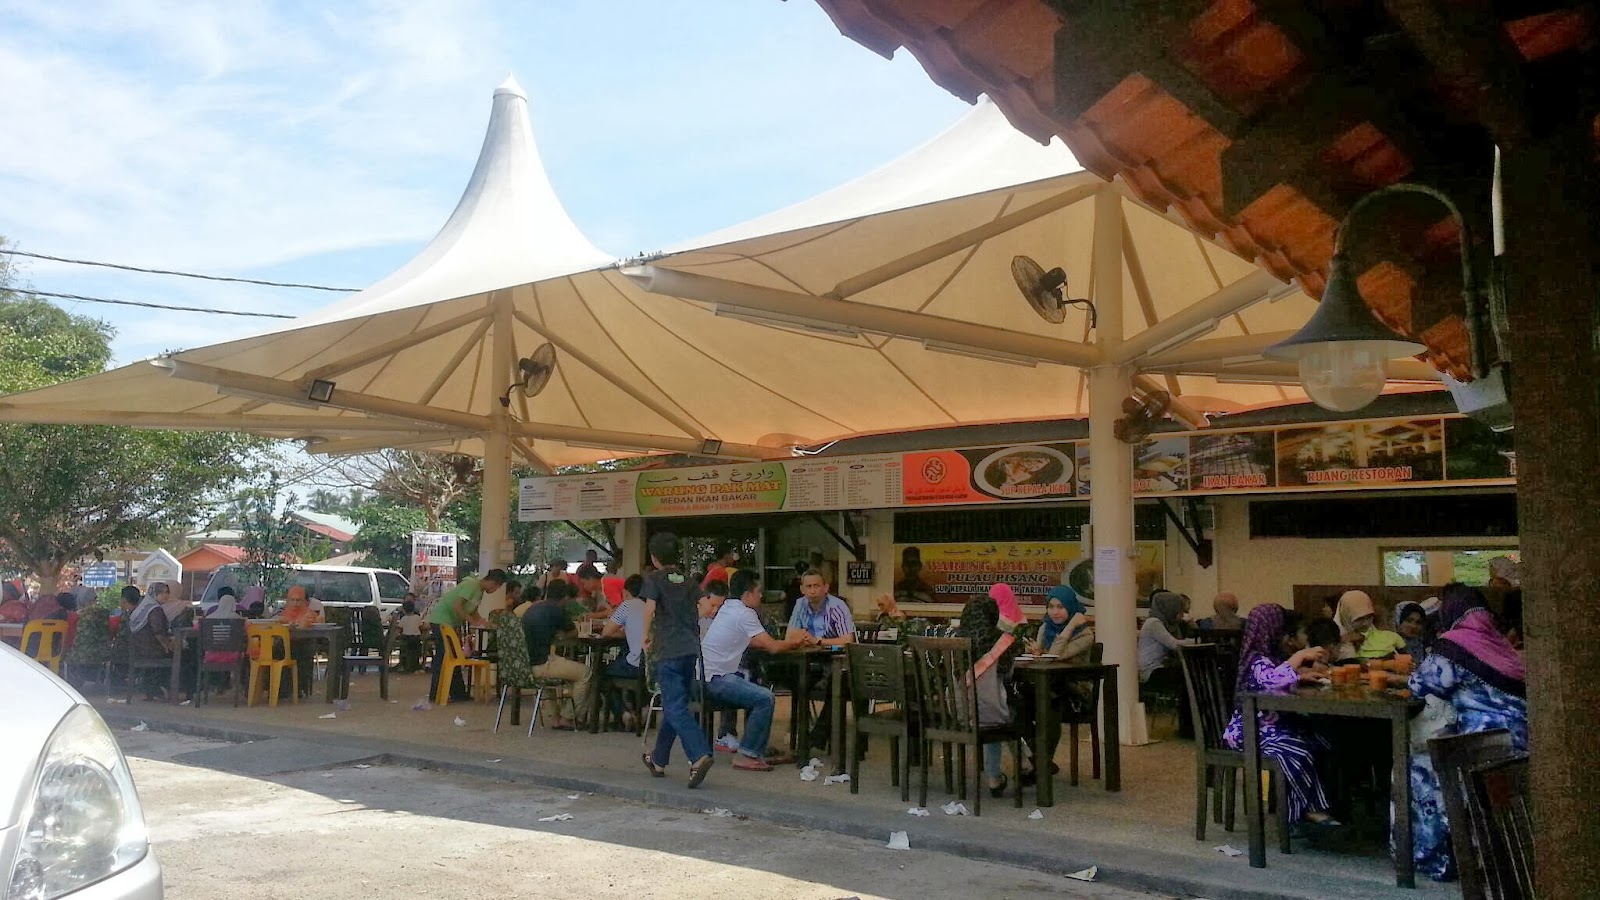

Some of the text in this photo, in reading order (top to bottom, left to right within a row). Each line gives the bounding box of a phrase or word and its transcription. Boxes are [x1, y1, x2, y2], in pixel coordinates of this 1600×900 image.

[1203, 474, 1266, 487] IKAN BAKAR
[1307, 466, 1412, 483] RUANG RESTORAN
[640, 480, 782, 497] WARUNG PAK MAT
[1000, 483, 1072, 495] SUP KEPALA IKAN
[660, 496, 693, 504] MEDAN
[721, 494, 757, 502] BAKAR
[430, 545, 453, 558] RIDE
[929, 560, 991, 572] WARUNG
[851, 569, 869, 579] CUTI
[947, 573, 1048, 583] PULAU PISANG
[949, 585, 975, 593] KEPALA
[976, 585, 990, 593] IKA
